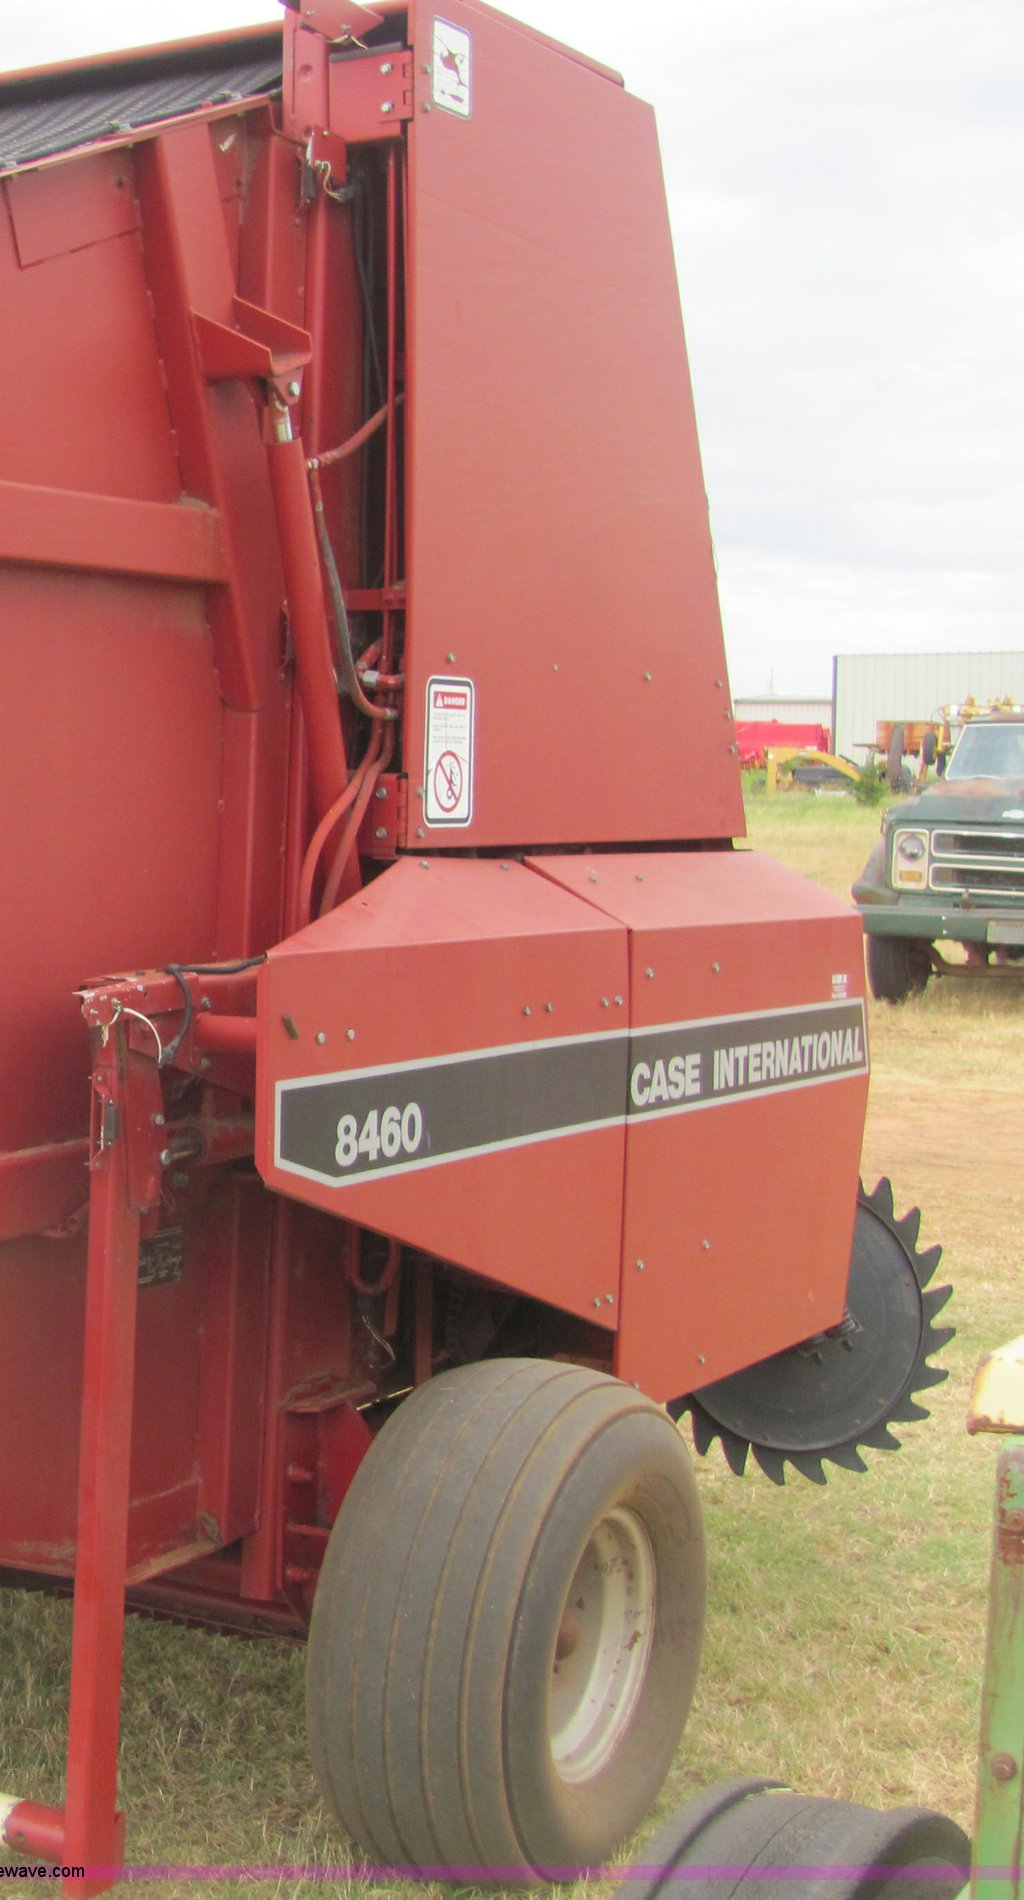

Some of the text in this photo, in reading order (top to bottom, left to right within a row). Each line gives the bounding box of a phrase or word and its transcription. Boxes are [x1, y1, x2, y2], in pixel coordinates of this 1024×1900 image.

[443, 696, 466, 706] DANGER
[630, 1027, 863, 1107] CASE INTERNATIONAL
[335, 1102, 423, 1167] 8460
